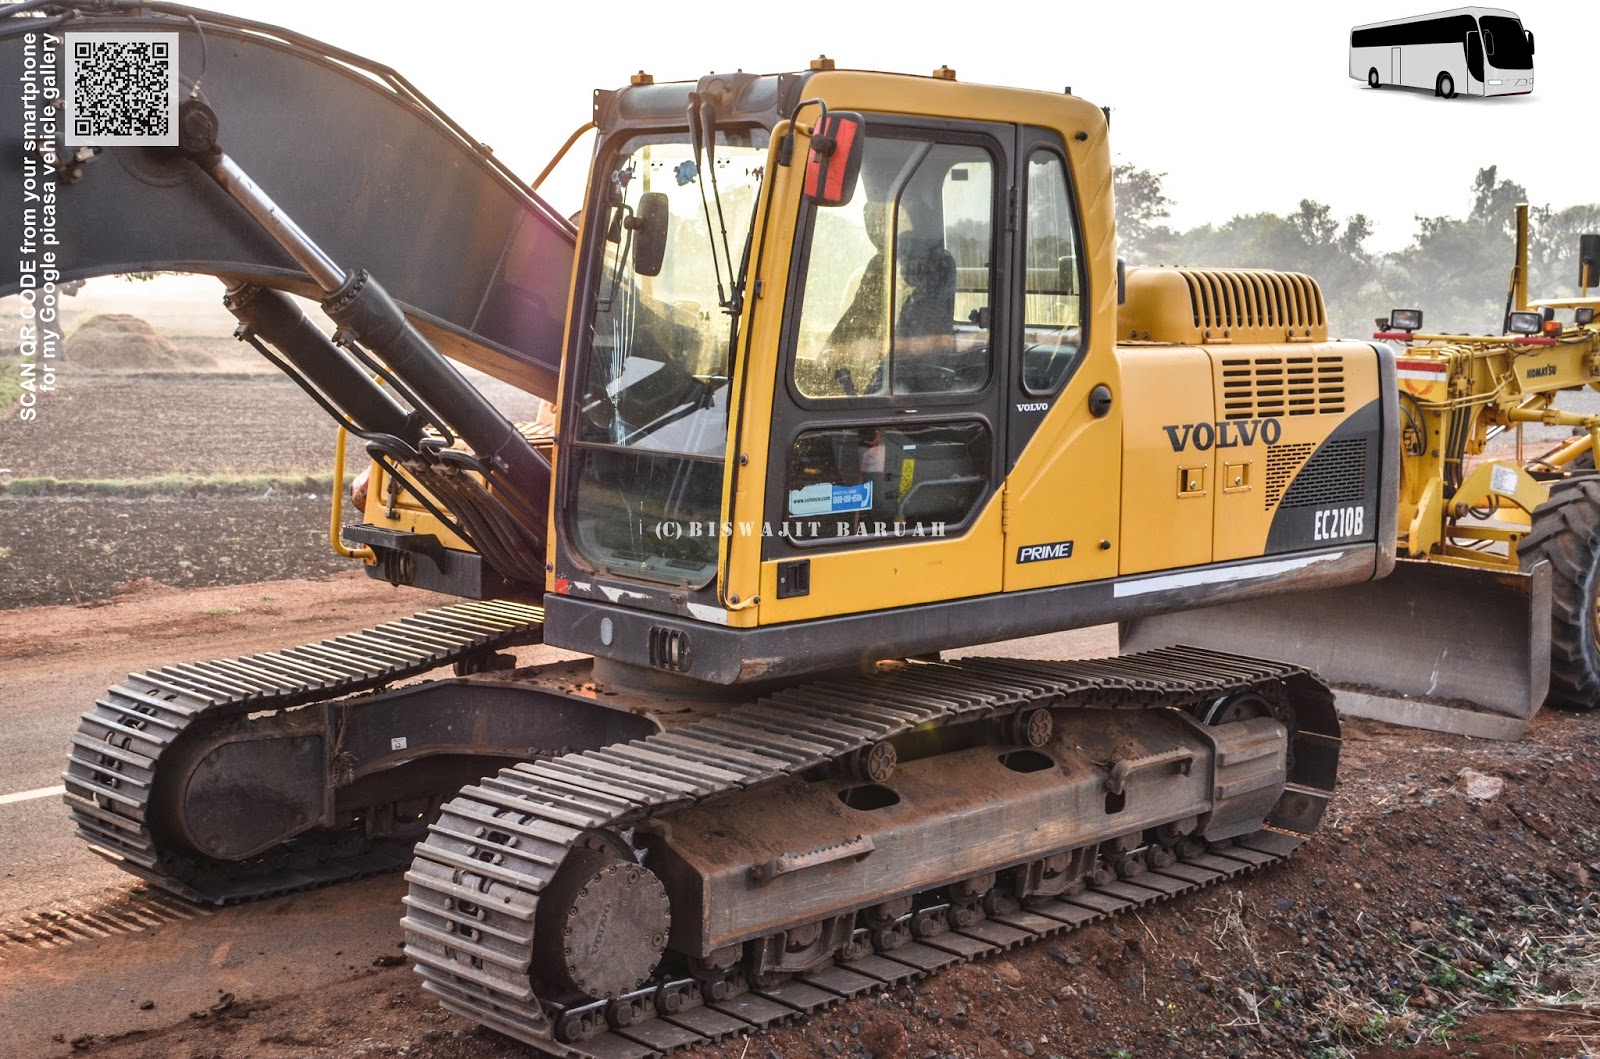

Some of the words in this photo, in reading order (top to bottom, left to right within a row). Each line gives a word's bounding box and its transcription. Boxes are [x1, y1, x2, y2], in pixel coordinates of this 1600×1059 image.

[1526, 364, 1557, 379] KOMATSU
[1016, 402, 1049, 412] VOLVO
[1162, 418, 1281, 452] VOLVO
[1314, 506, 1364, 541] EC210B
[1020, 543, 1070, 562] PRIME
